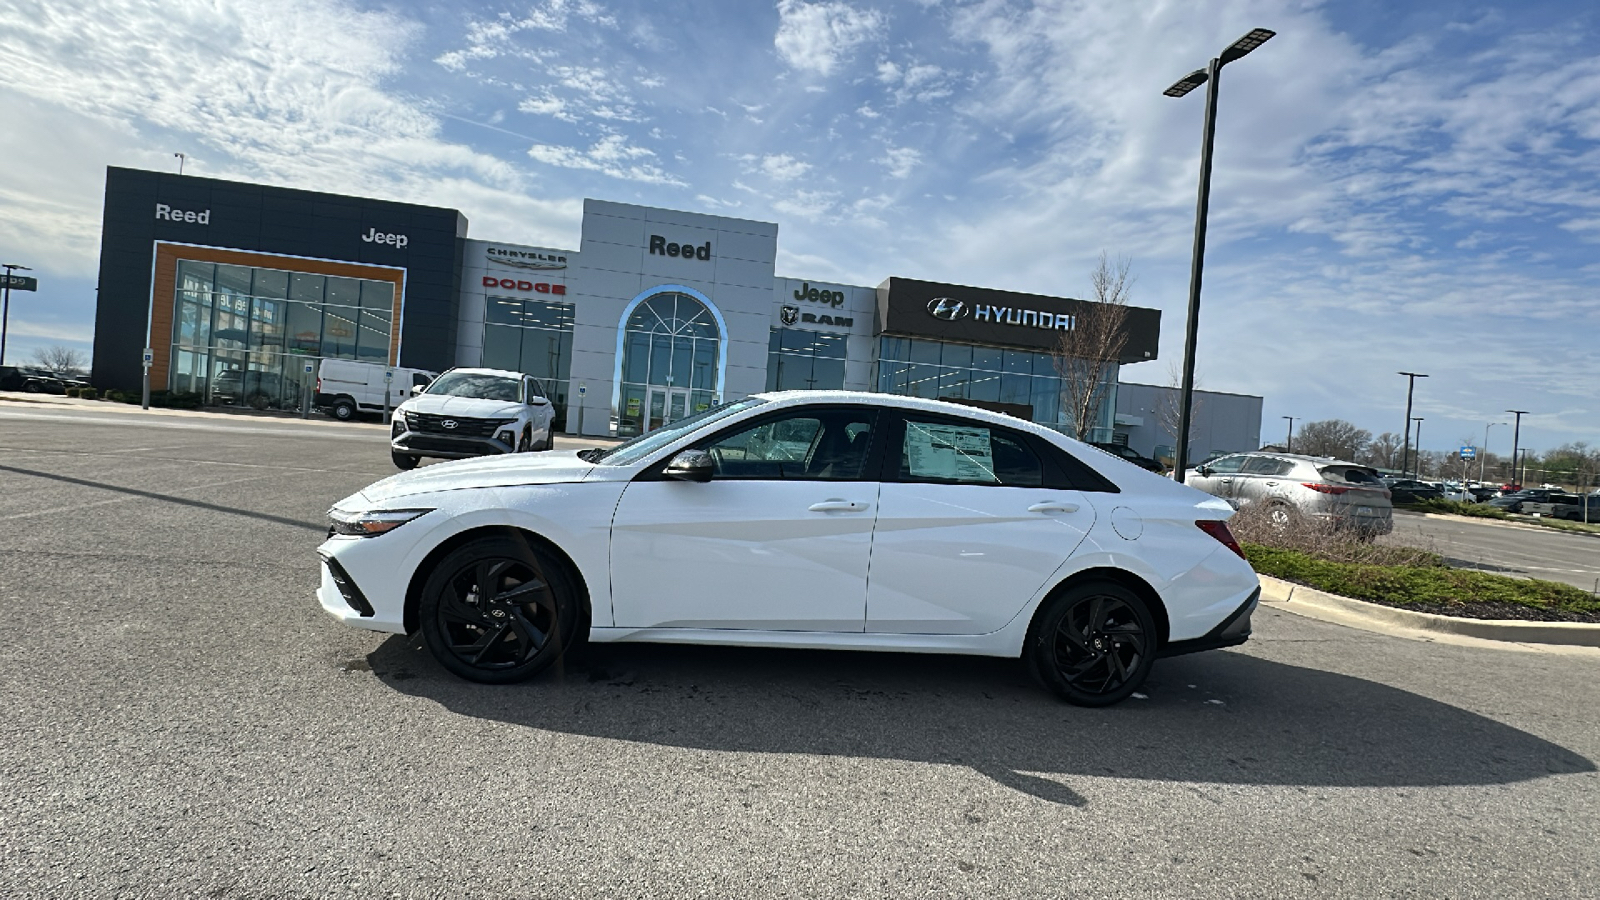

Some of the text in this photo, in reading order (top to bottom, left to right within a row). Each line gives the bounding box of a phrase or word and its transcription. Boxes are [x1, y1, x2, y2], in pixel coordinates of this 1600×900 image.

[155, 203, 210, 225] Reed
[361, 227, 408, 249] Jeep
[650, 234, 711, 261] Reed
[487, 247, 567, 263] CHRYSLER
[483, 276, 566, 295] DODGE
[794, 282, 844, 308] Jeep
[802, 312, 853, 328] RAM
[975, 304, 1076, 331] HYUNDAI
